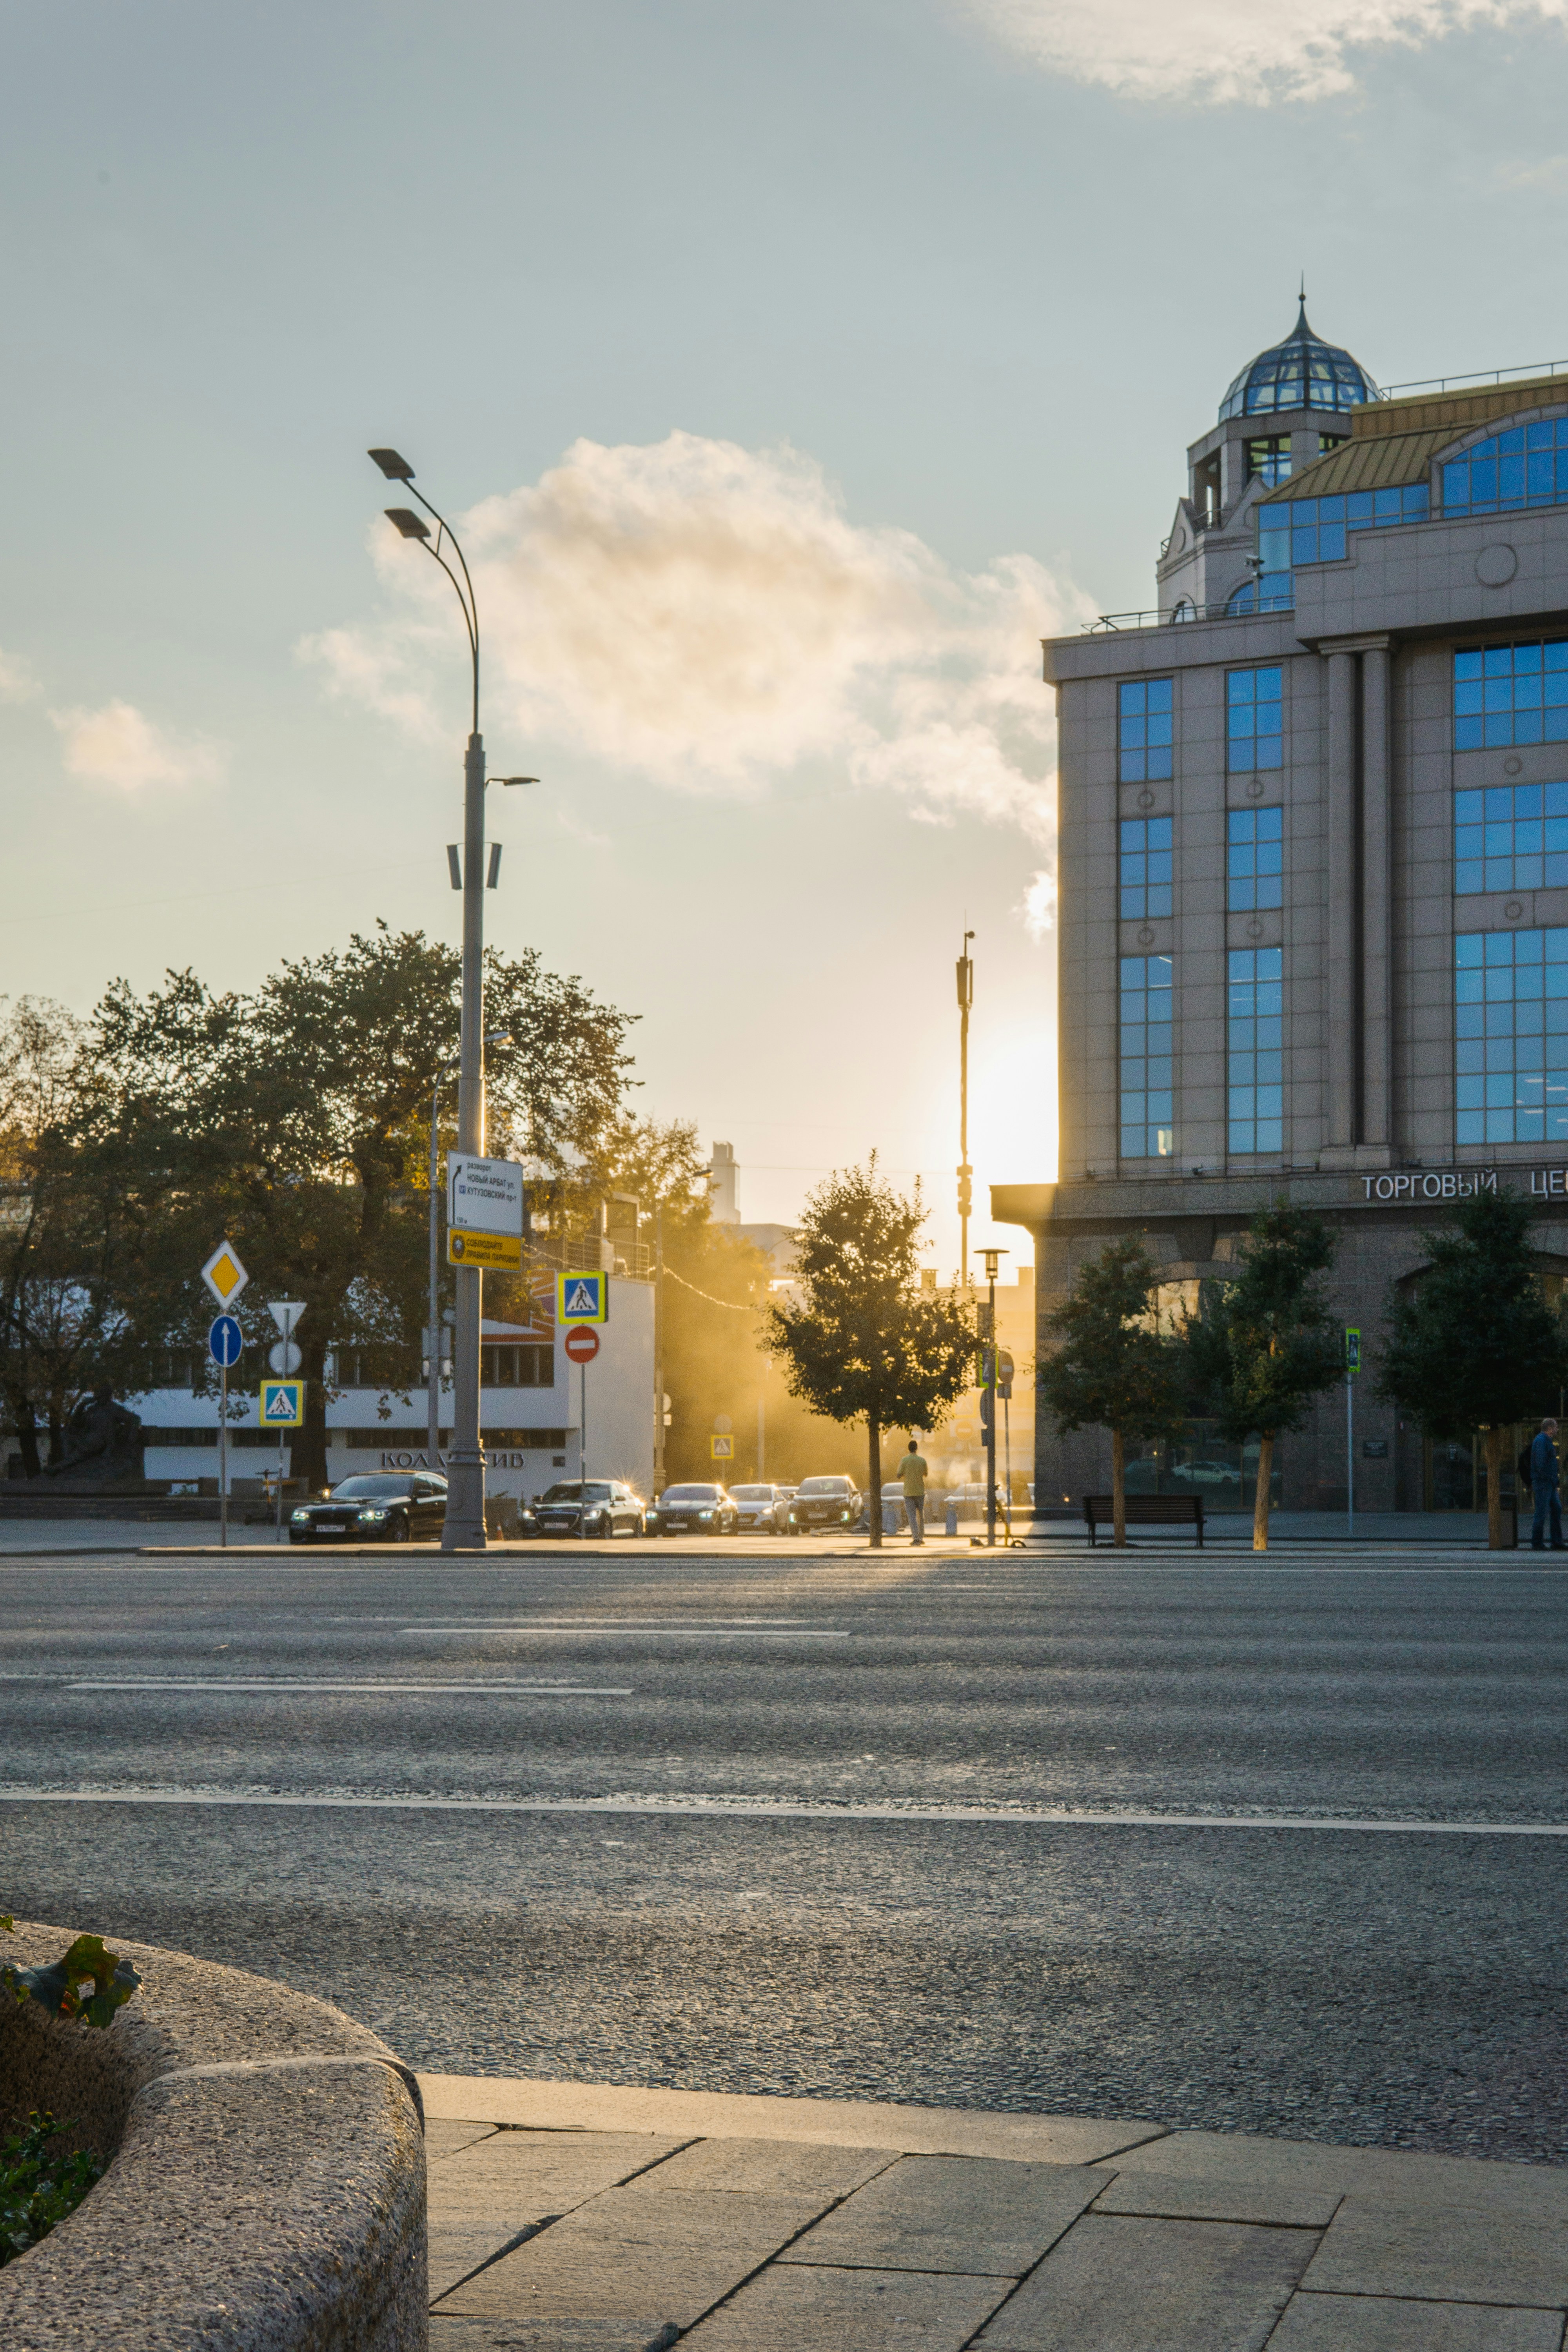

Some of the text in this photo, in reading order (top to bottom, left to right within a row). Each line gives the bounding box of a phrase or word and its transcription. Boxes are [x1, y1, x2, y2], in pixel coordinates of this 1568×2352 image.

[467, 1162, 491, 1172] разворот
[467, 1173, 488, 1184] НОВЫЙ
[490, 1178, 506, 1187] АРБАТ
[1361, 1168, 1568, 1200] ТОРГОВЫЙ ЦЕ
[467, 1186, 505, 1200] КУТУЗОВСКИЙ
[466, 1238, 503, 1250] СОБЛЮДАЙТЕ
